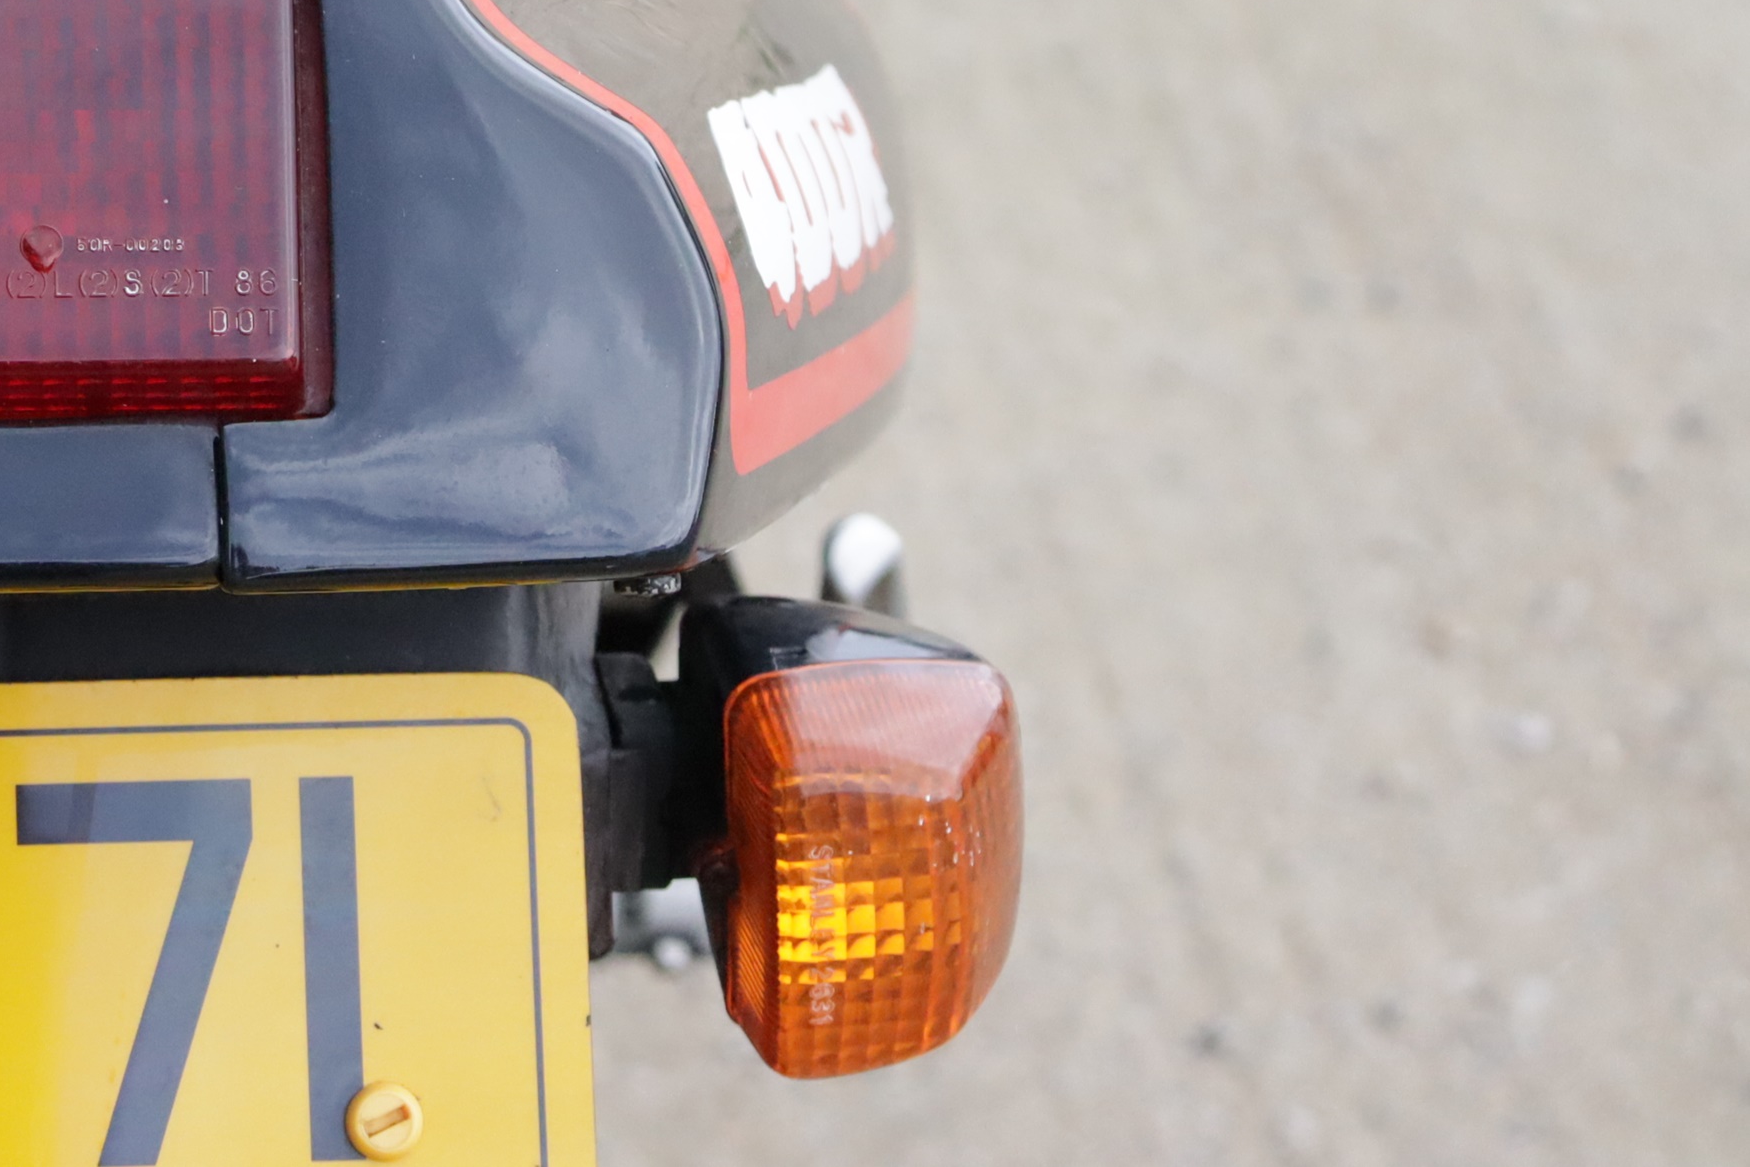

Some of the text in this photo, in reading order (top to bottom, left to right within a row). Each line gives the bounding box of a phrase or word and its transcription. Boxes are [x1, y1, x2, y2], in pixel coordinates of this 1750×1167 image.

[234, 267, 278, 296] 86
[208, 307, 278, 336] DOT
[808, 844, 838, 960] STANLEY
